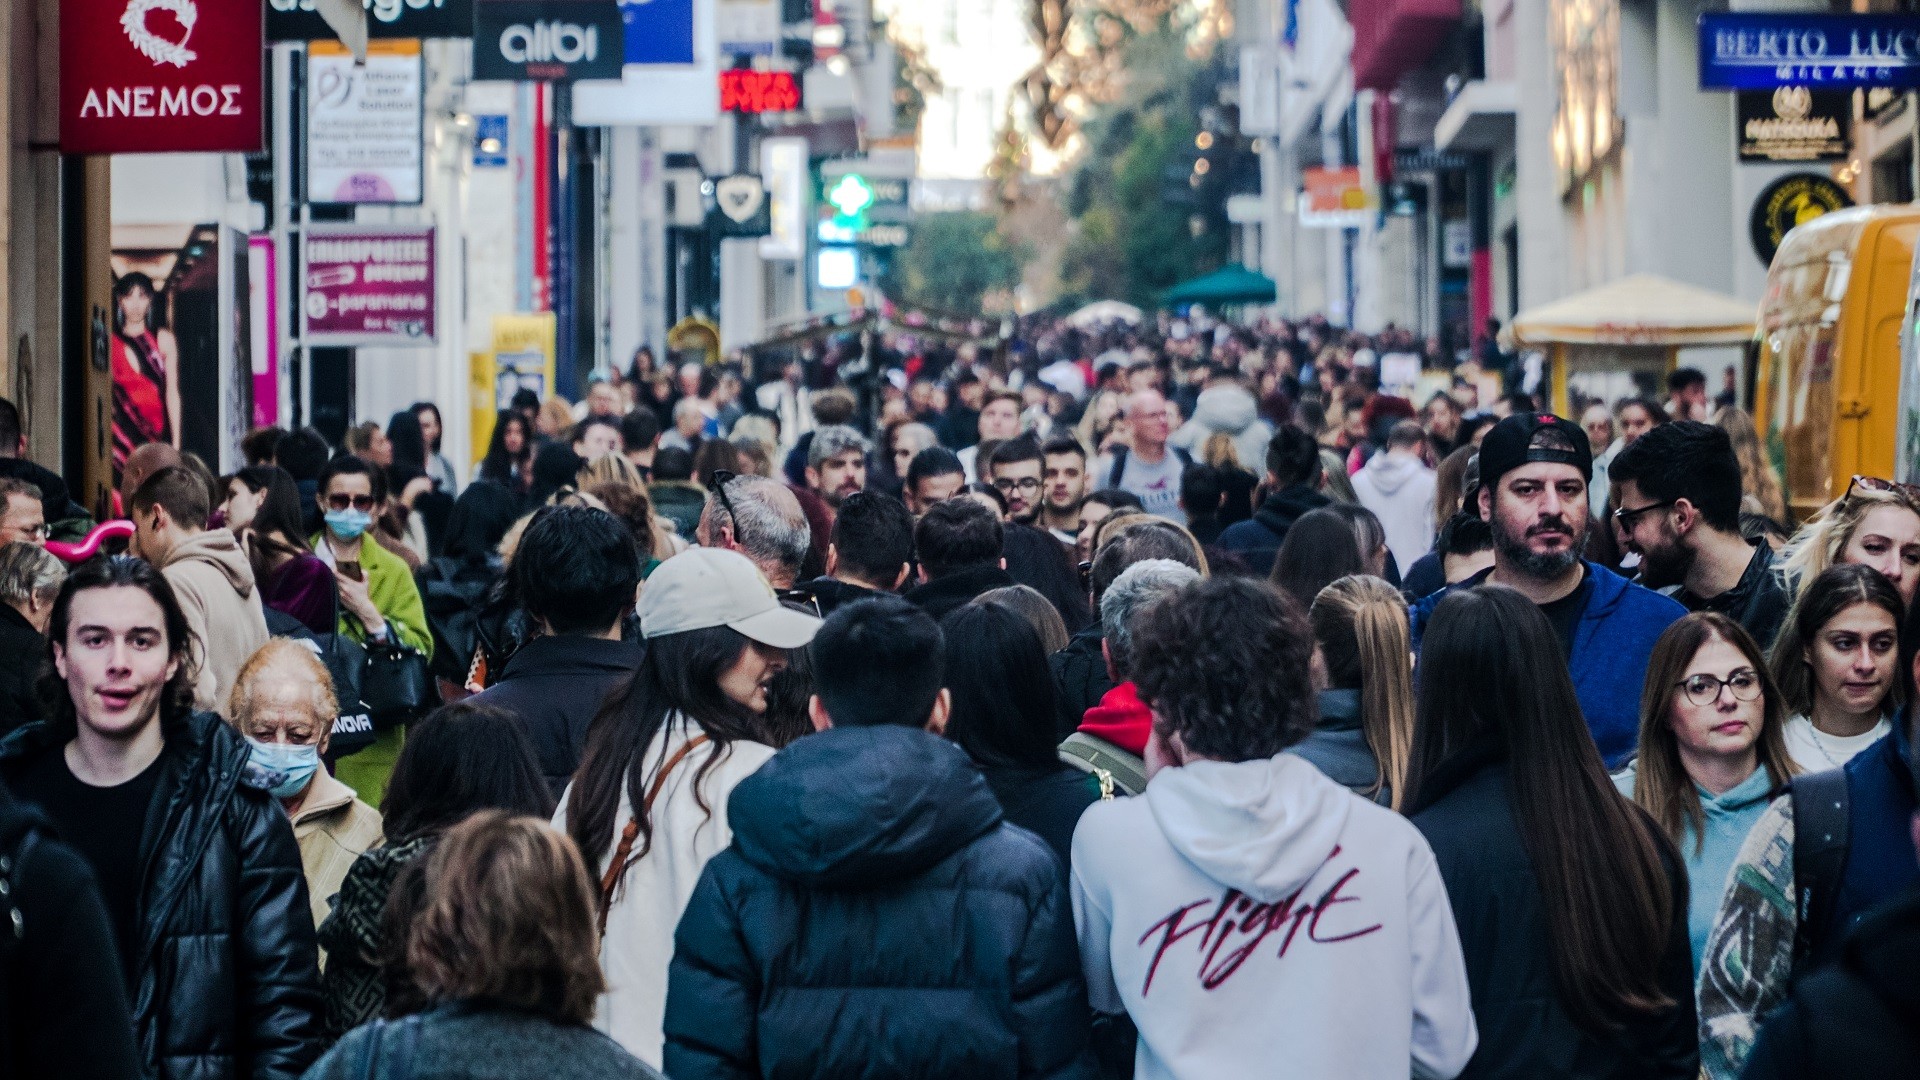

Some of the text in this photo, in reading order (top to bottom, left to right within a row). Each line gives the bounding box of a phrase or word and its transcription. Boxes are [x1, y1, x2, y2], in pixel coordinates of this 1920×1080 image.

[499, 19, 599, 63] alibi
[1715, 28, 1920, 60] BERTO LUC
[80, 85, 242, 118] ΑΝΕΜΟΣ
[1137, 843, 1383, 999] Flight
